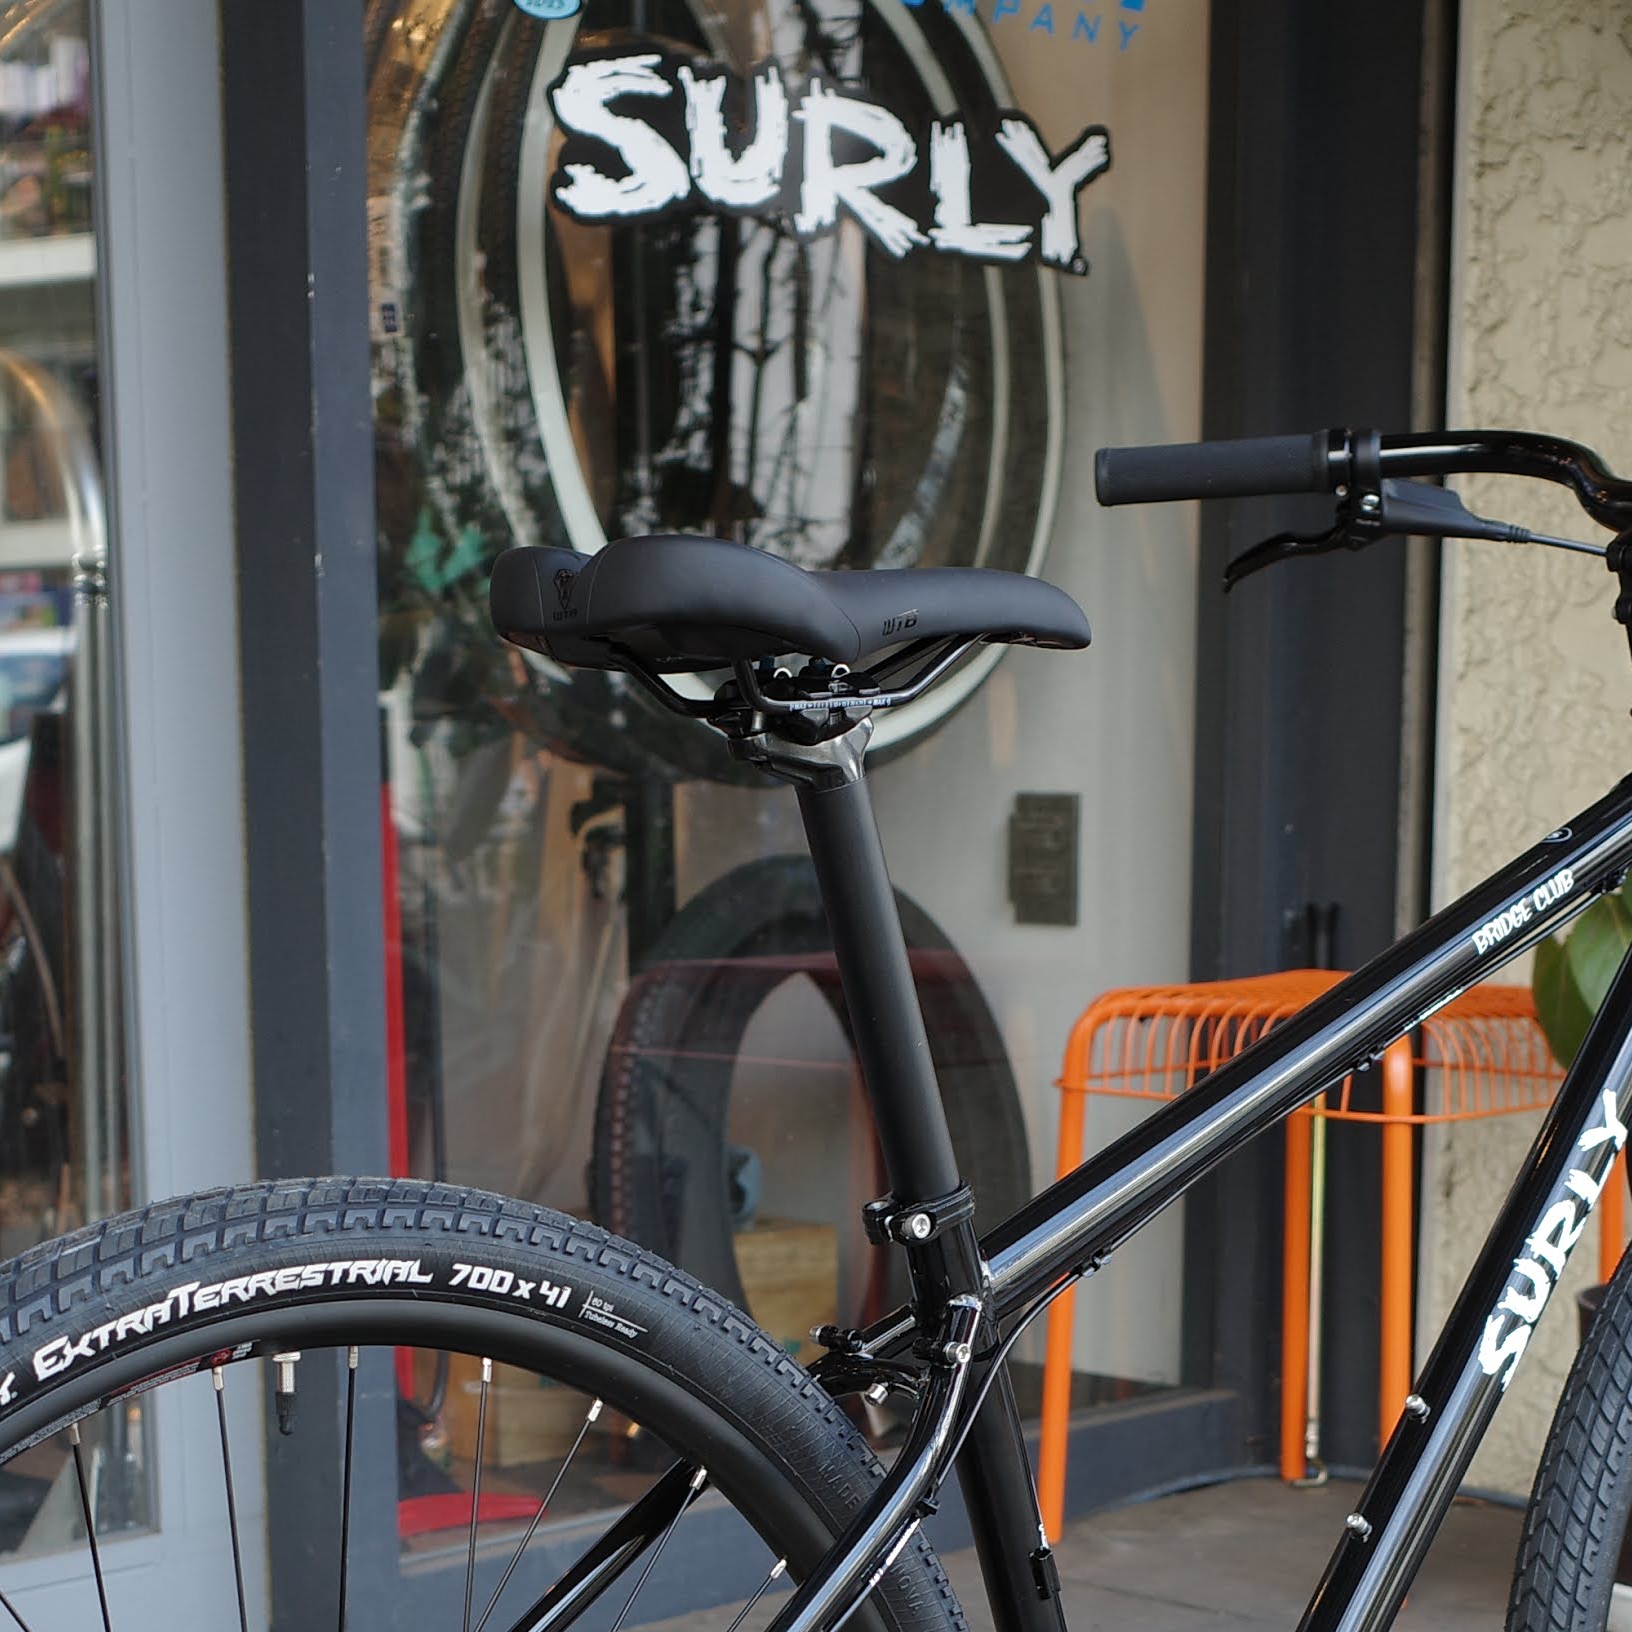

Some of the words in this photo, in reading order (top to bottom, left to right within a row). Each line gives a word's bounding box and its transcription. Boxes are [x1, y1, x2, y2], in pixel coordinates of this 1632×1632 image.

[552, 54, 1108, 262] SURLY
[1471, 897, 1534, 956] BRIDGE
[1532, 868, 1575, 913] CLUB
